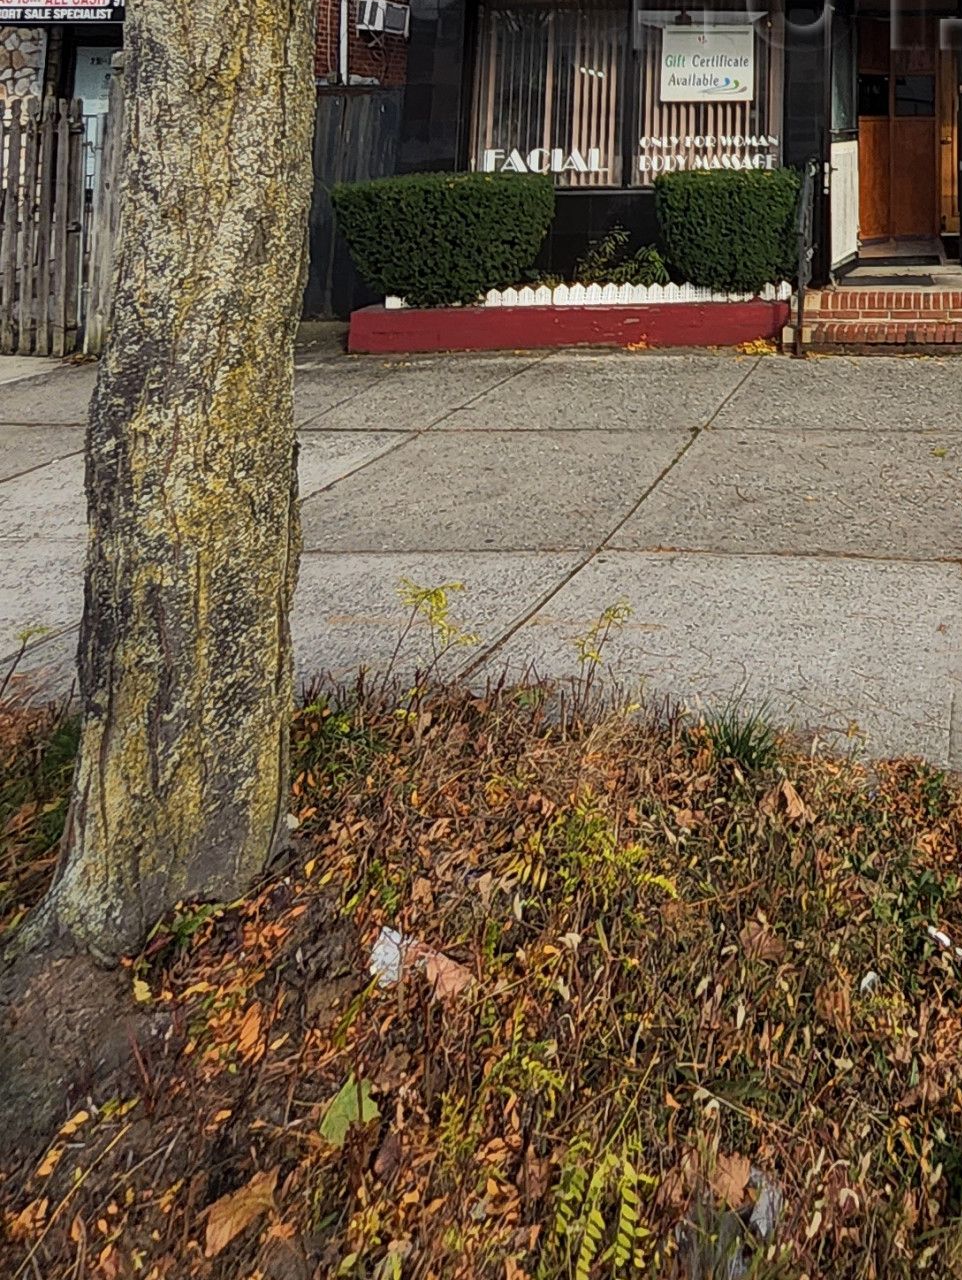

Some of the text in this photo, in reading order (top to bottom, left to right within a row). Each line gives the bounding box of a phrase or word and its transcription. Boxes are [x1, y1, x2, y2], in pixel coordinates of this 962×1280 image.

[24, 9, 51, 20] SALE
[53, 9, 113, 20] SPECIALIST
[665, 54, 749, 68] Gift Certificate
[668, 73, 720, 86] Available
[639, 135, 780, 148] ONLY FOR WOMAN
[483, 147, 609, 173] FACIAL
[639, 153, 778, 172] BODY MASSAGE
